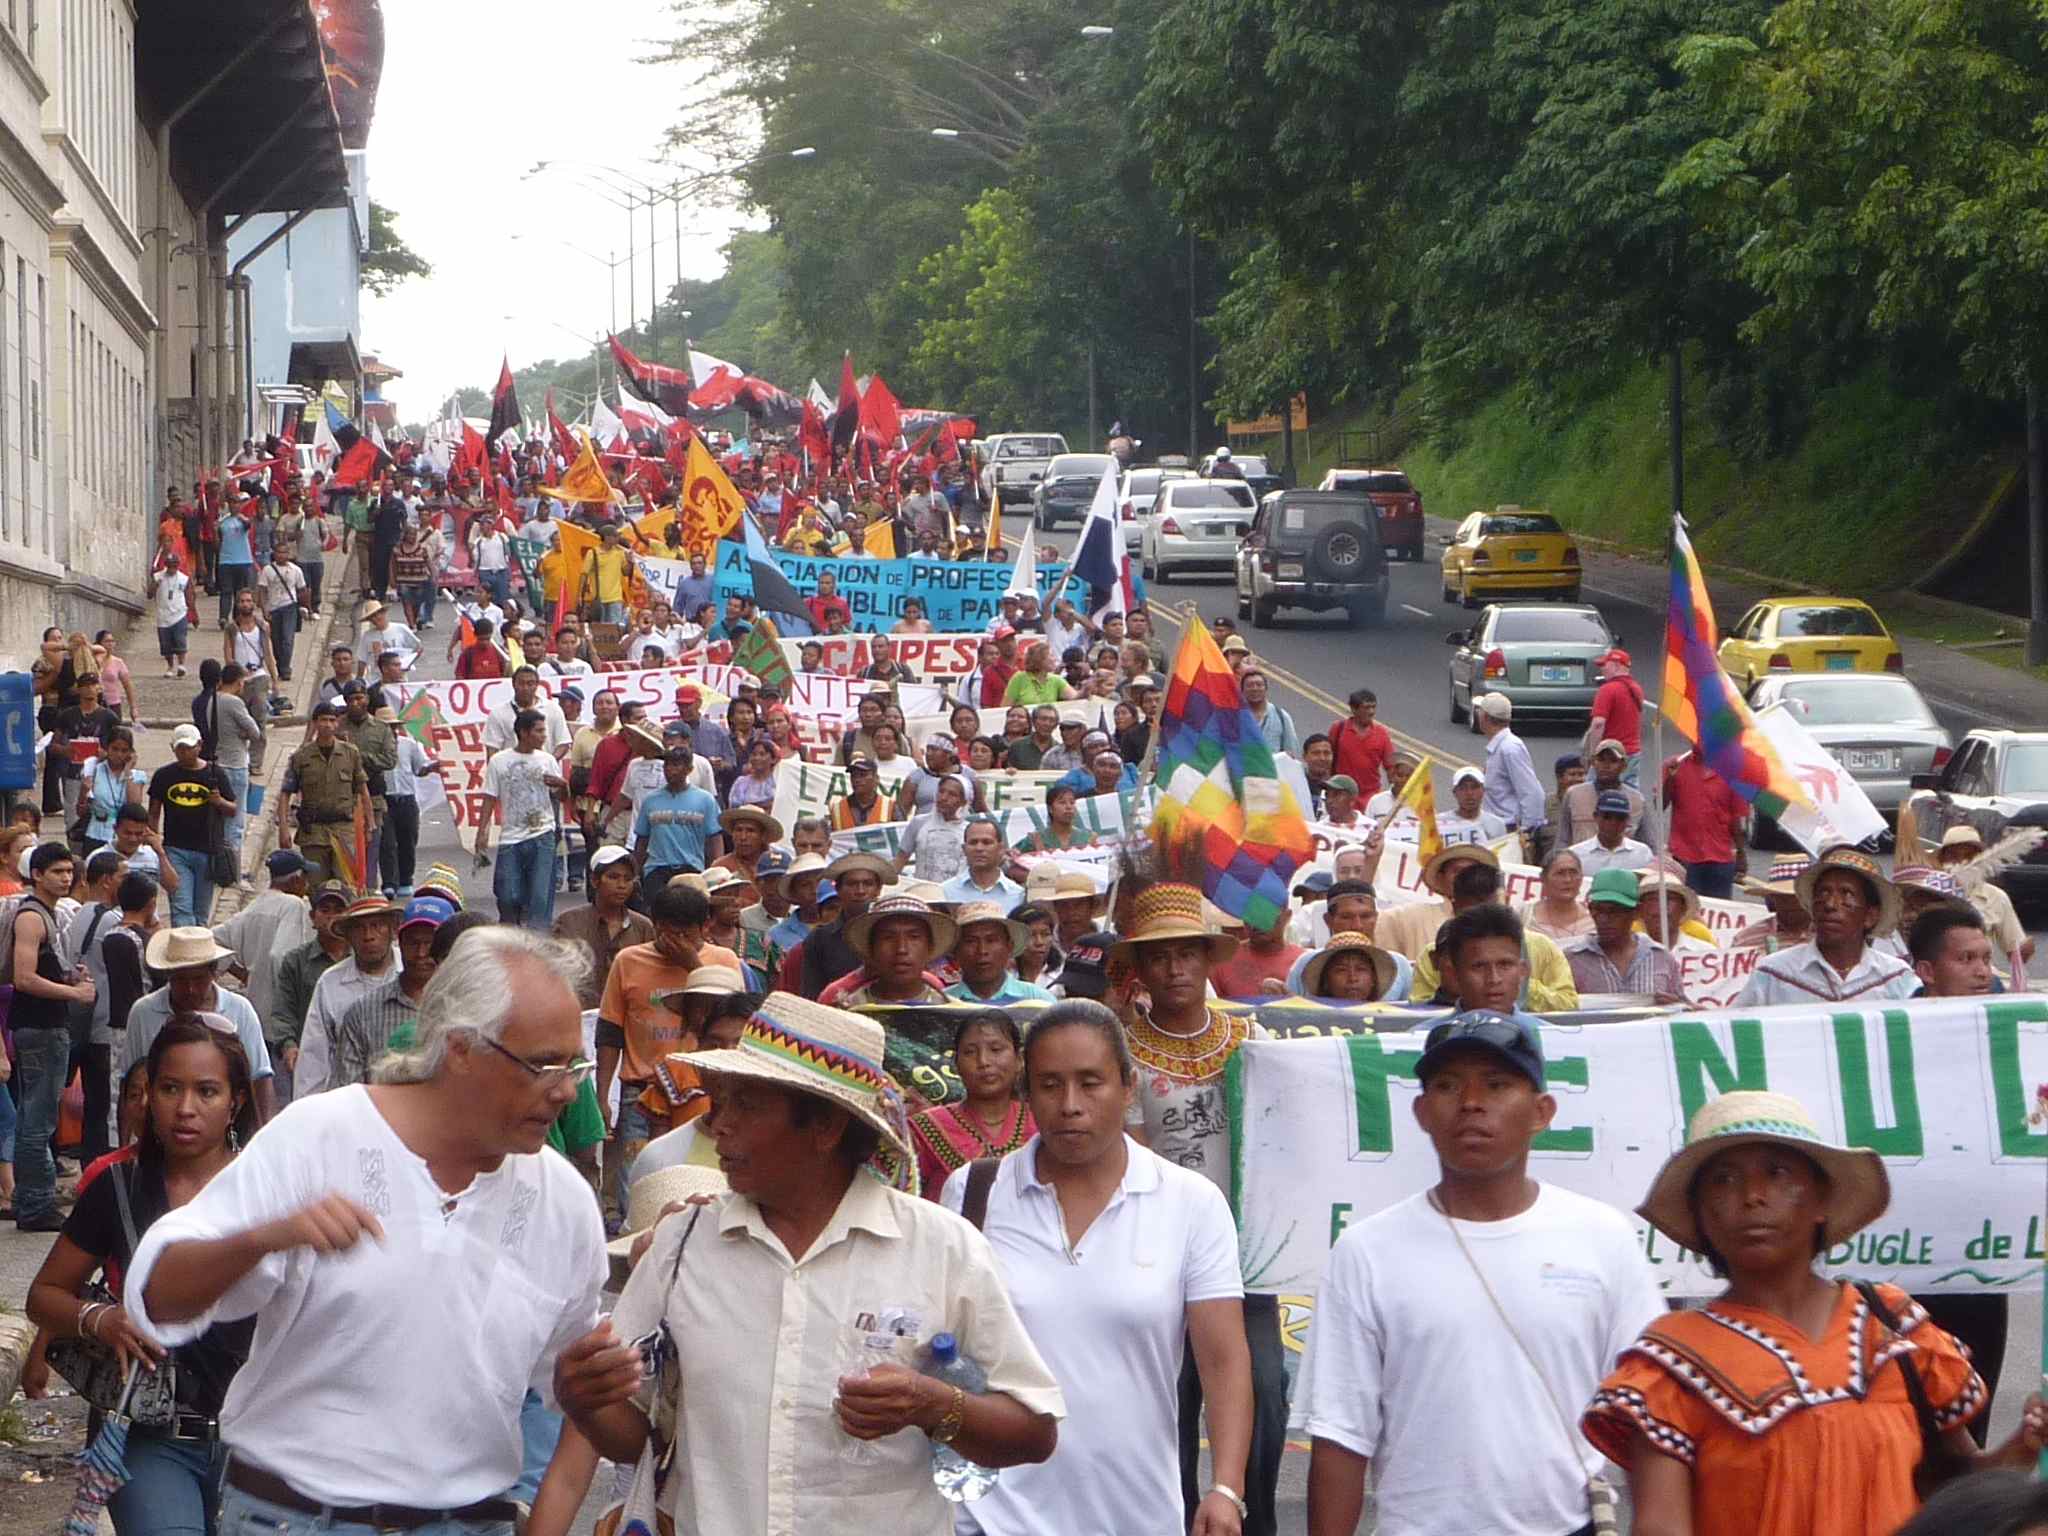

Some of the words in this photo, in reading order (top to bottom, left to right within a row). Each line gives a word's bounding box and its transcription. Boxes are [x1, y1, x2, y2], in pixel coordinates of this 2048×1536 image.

[886, 573, 903, 586] DE
[911, 564, 1081, 592] PROFESRES
[937, 608, 954, 621] DE
[1964, 1218, 2013, 1261] de
